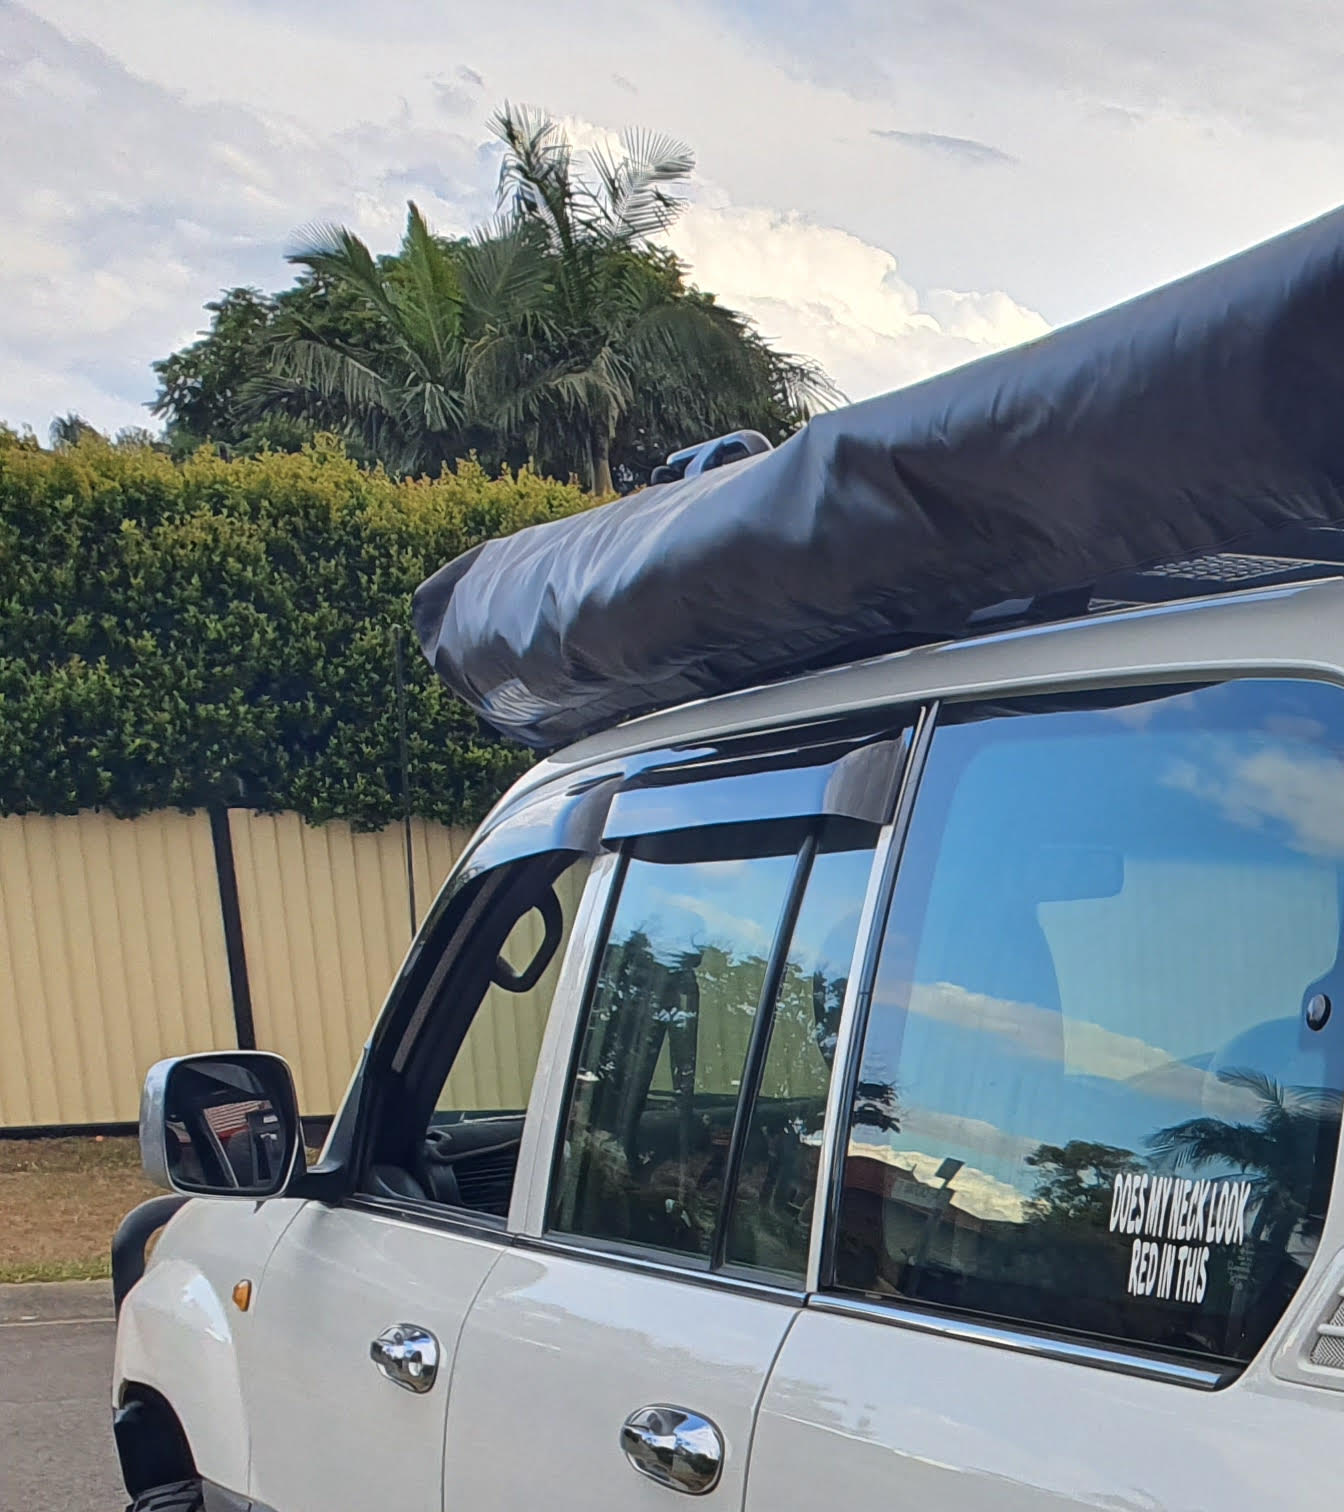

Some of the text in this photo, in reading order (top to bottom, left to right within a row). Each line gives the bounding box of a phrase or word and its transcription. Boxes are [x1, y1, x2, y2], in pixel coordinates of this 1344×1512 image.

[1109, 1173, 1251, 1246] DOES MY NECK LOOK
[1128, 1238, 1210, 1304] RED IN THIS
